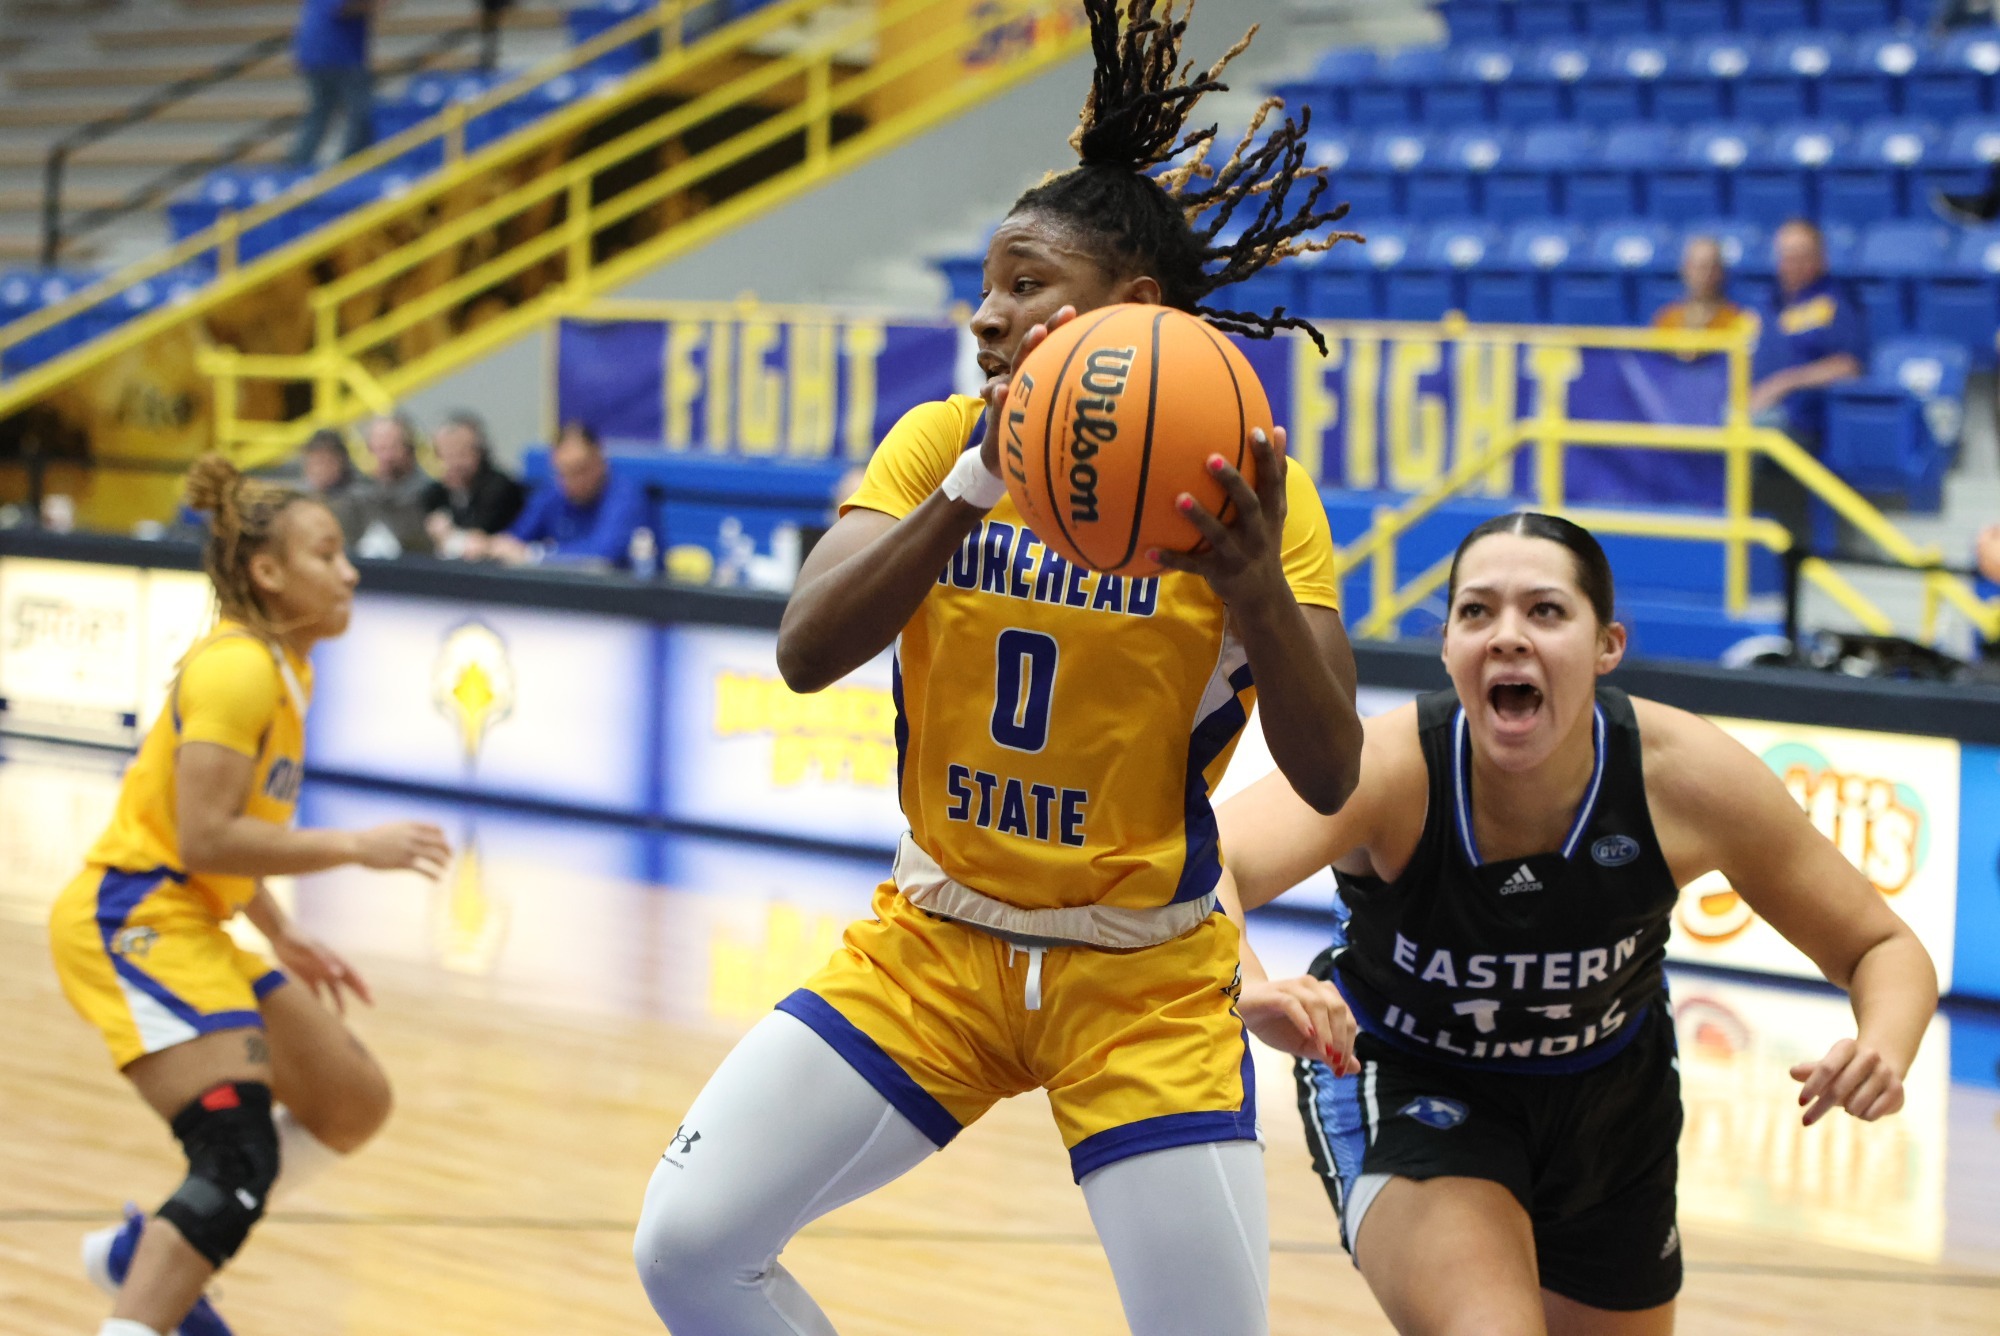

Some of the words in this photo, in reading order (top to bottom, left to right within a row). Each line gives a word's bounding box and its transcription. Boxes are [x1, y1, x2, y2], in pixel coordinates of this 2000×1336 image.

[664, 318, 887, 456] FIGHT
[1069, 345, 1137, 523] Wilson
[1290, 335, 1584, 504] FIGHT
[937, 519, 1160, 618] OREHEAD
[989, 627, 1060, 754] 0
[946, 763, 1089, 847] STATE
[1500, 881, 1543, 895] adidas
[1393, 930, 1643, 990] EASTERN
